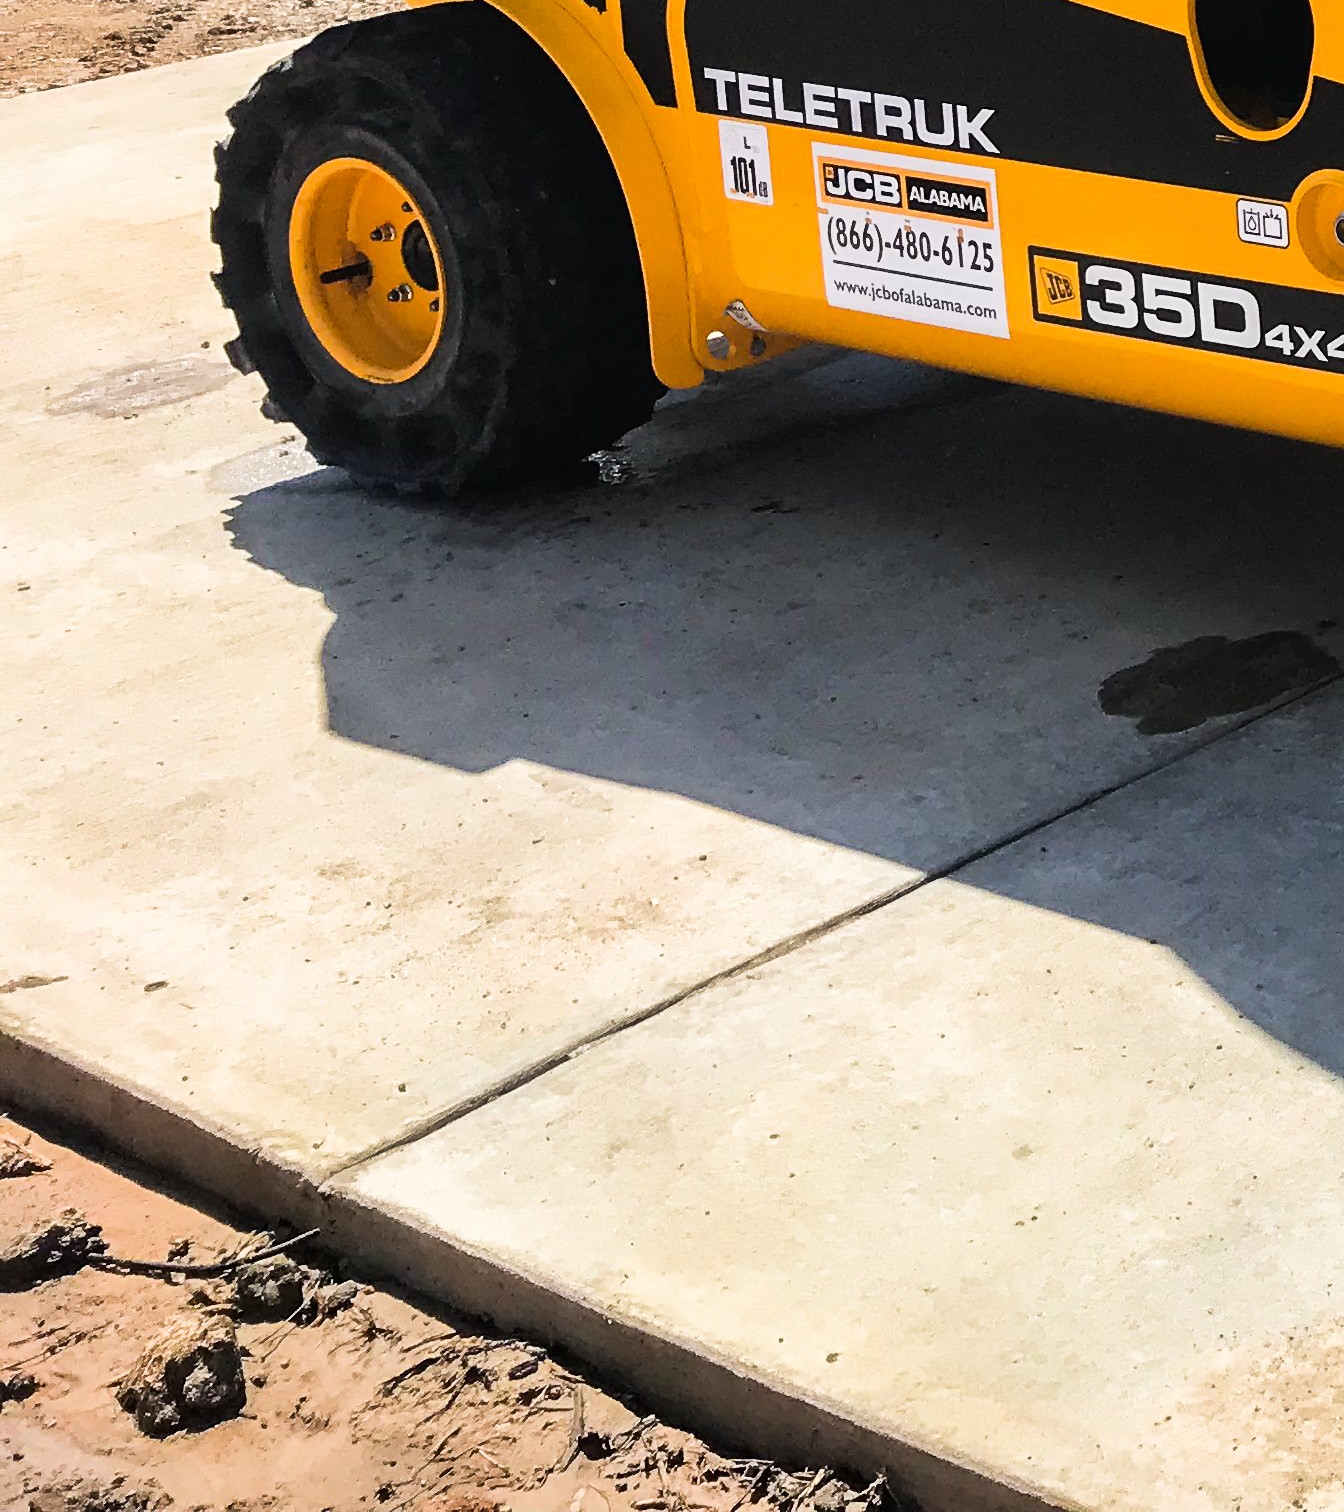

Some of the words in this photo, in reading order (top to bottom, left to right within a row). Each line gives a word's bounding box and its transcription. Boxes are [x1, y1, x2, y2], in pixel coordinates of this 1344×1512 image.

[703, 67, 1000, 154] TELETRUK
[730, 156, 757, 196] 101
[826, 168, 900, 205] JCB
[909, 186, 985, 213] ALABAMA
[827, 216, 994, 273] (866)-480-6125
[834, 280, 997, 319] www.jcbofalabama.com
[1046, 272, 1074, 302] JCB
[1084, 264, 1261, 349] 35D
